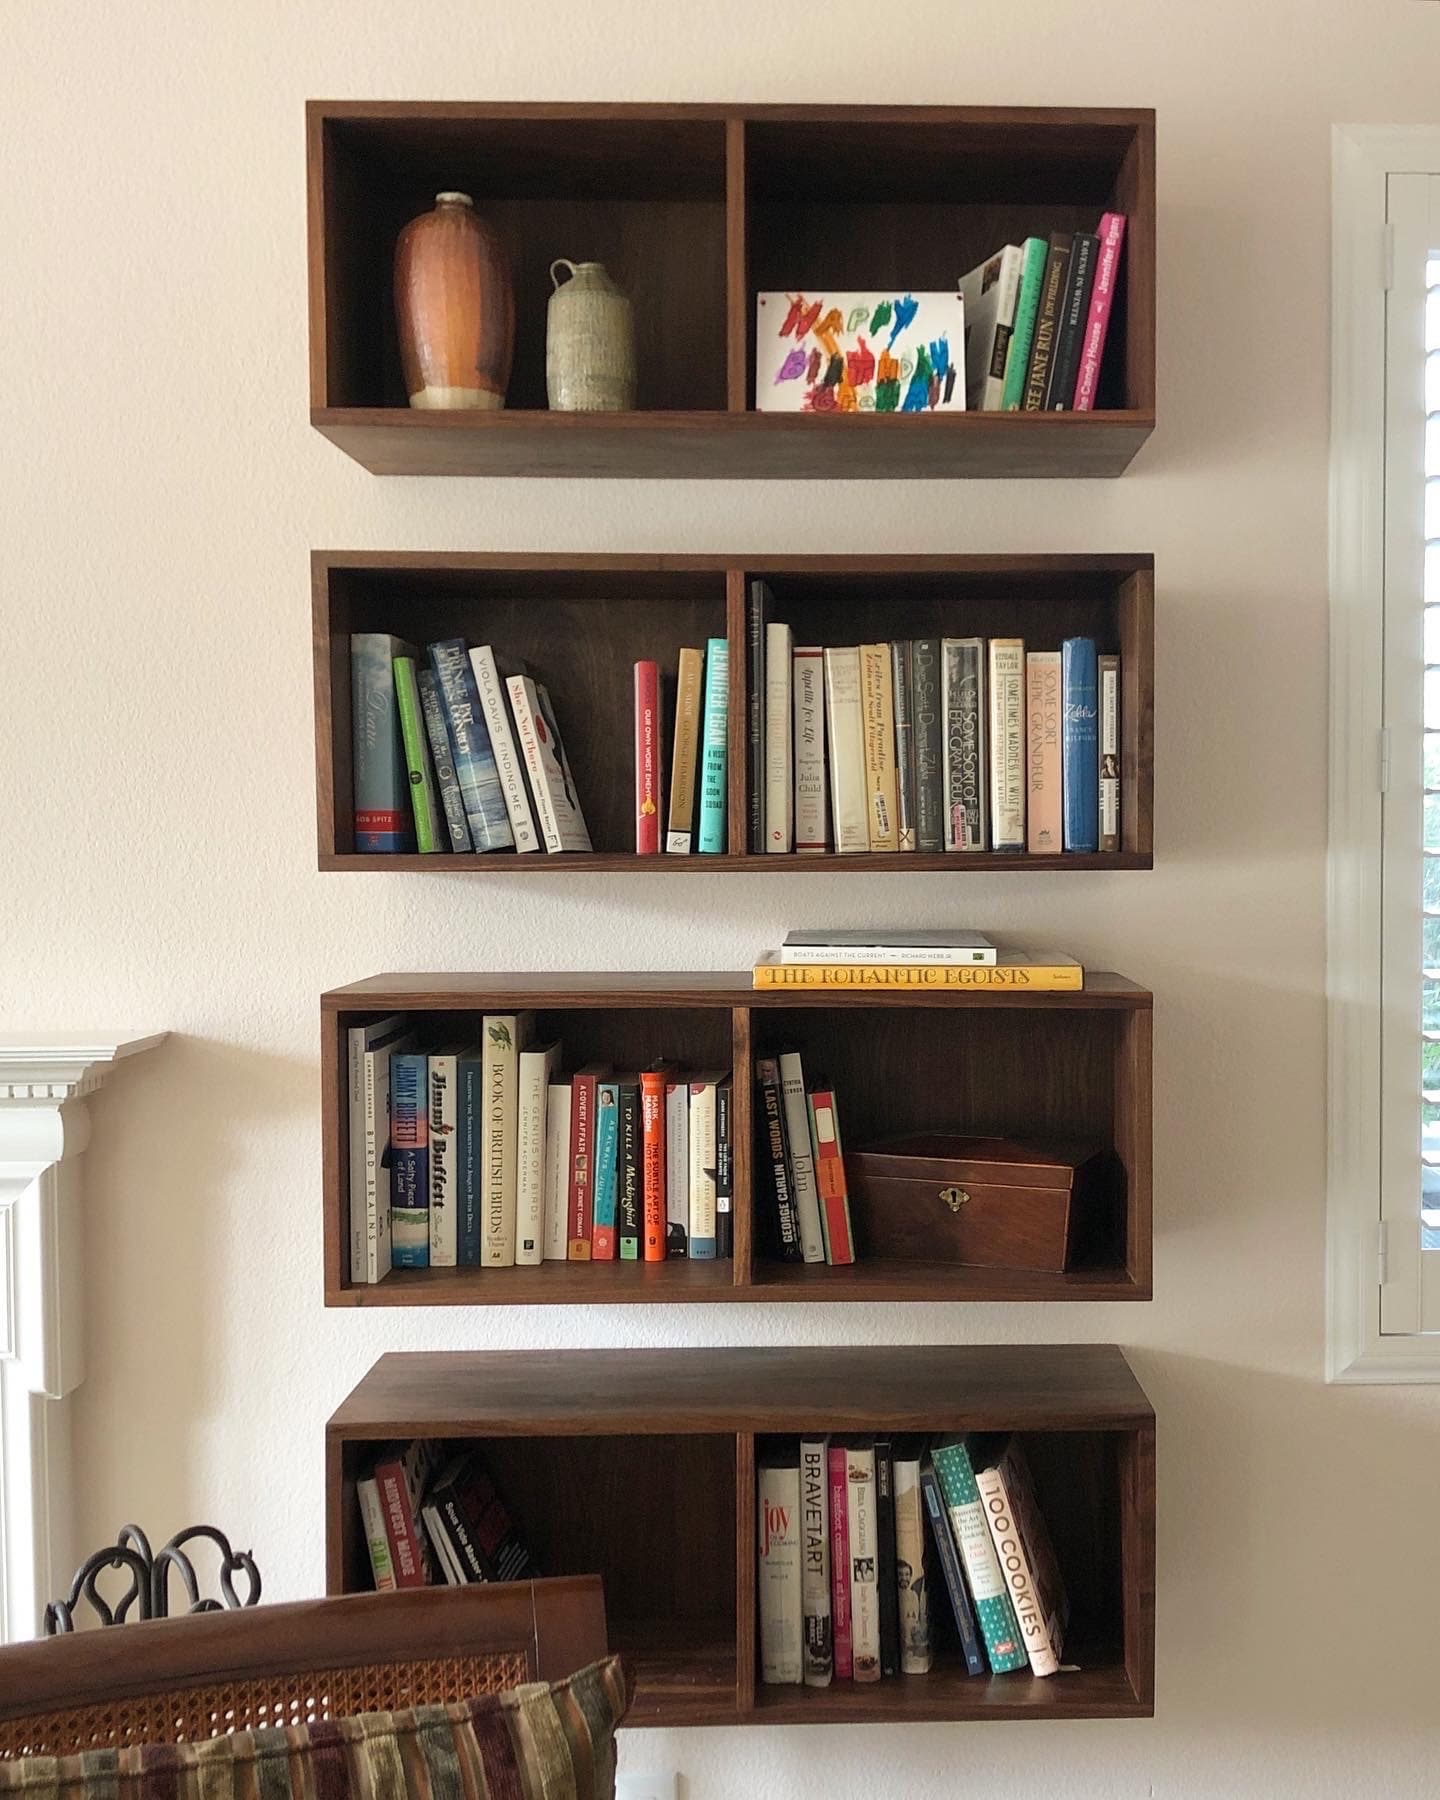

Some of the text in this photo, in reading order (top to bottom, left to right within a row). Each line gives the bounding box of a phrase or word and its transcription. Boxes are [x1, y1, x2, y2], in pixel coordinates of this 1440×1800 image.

[1099, 217, 1121, 294] Jennifer Egan
[1088, 322, 1102, 358] House
[1026, 318, 1055, 411] SEE JANE RUN
[1081, 358, 1096, 394] Candy
[447, 647, 469, 700] PRINCE
[874, 653, 884, 689] Exiles
[995, 662, 1018, 670] TAYLOR
[709, 646, 728, 747] JENNIFER EGAN
[802, 669, 814, 744] Appetite for Life
[875, 691, 885, 719] from
[1044, 670, 1056, 707] SOME
[449, 704, 471, 754] CONROY
[458, 702, 474, 725] PAT
[511, 683, 539, 773] She's Not There
[866, 653, 877, 773] Zelda and Scott Fitzgerald
[949, 709, 963, 735] EPIC
[962, 711, 977, 750] SOME
[1007, 679, 1019, 782] SOMETIMES MADNESS IS
[1044, 712, 1056, 747] SORT
[478, 658, 522, 811] VIOLA DAVIS FINDING ME
[876, 722, 887, 773] Paradise
[1031, 680, 1044, 792] EPIC GRANDEUR
[679, 720, 690, 809] GEORGE HARRISON
[706, 775, 717, 784] THE
[707, 762, 722, 771] FROM
[800, 774, 820, 782] Julia
[949, 736, 963, 808] GRANDEUR
[962, 751, 977, 786] SORT
[798, 784, 821, 792] Child
[962, 786, 977, 804] OF
[372, 815, 393, 823] SPITZ
[857, 952, 886, 960] CURRENT
[901, 952, 927, 960] RICHARD
[765, 968, 1031, 985] THE ROMANTIC EGOISTS
[396, 1064, 417, 1144] JIMMY BUFFETT
[579, 1091, 587, 1121] COVERT
[625, 1107, 633, 1120] TO
[430, 1071, 448, 1209] Jimmy Buffett
[578, 1122, 586, 1153] AFFAIR
[608, 1120, 615, 1131] AS
[624, 1124, 633, 1150] KILL
[764, 1090, 784, 1159] LAST WORDS
[491, 1063, 505, 1234] BOOK OF BRITISH BIRDS
[529, 1076, 541, 1222] THE GENIUS OF BIRDS
[397, 1161, 405, 1193] of Land
[406, 1151, 416, 1206] A Salty Piece
[521, 1149, 529, 1194] ACKERMAN
[773, 1163, 788, 1201] CARLIN
[792, 1152, 808, 1192] John
[368, 1180, 376, 1241] BRAINS
[576, 1187, 584, 1237] JENNET CONANT
[622, 1164, 636, 1228] Mockingbird
[652, 1213, 659, 1226] OF
[778, 1203, 793, 1243] GEORGE
[383, 1477, 416, 1577] MIDWEST MADE
[445, 1501, 459, 1526] Sous
[804, 1453, 824, 1577] BRAVETART
[833, 1485, 843, 1530] barefoot
[985, 1487, 1010, 1532] 100
[1001, 1539, 1041, 1637] COOKIES
